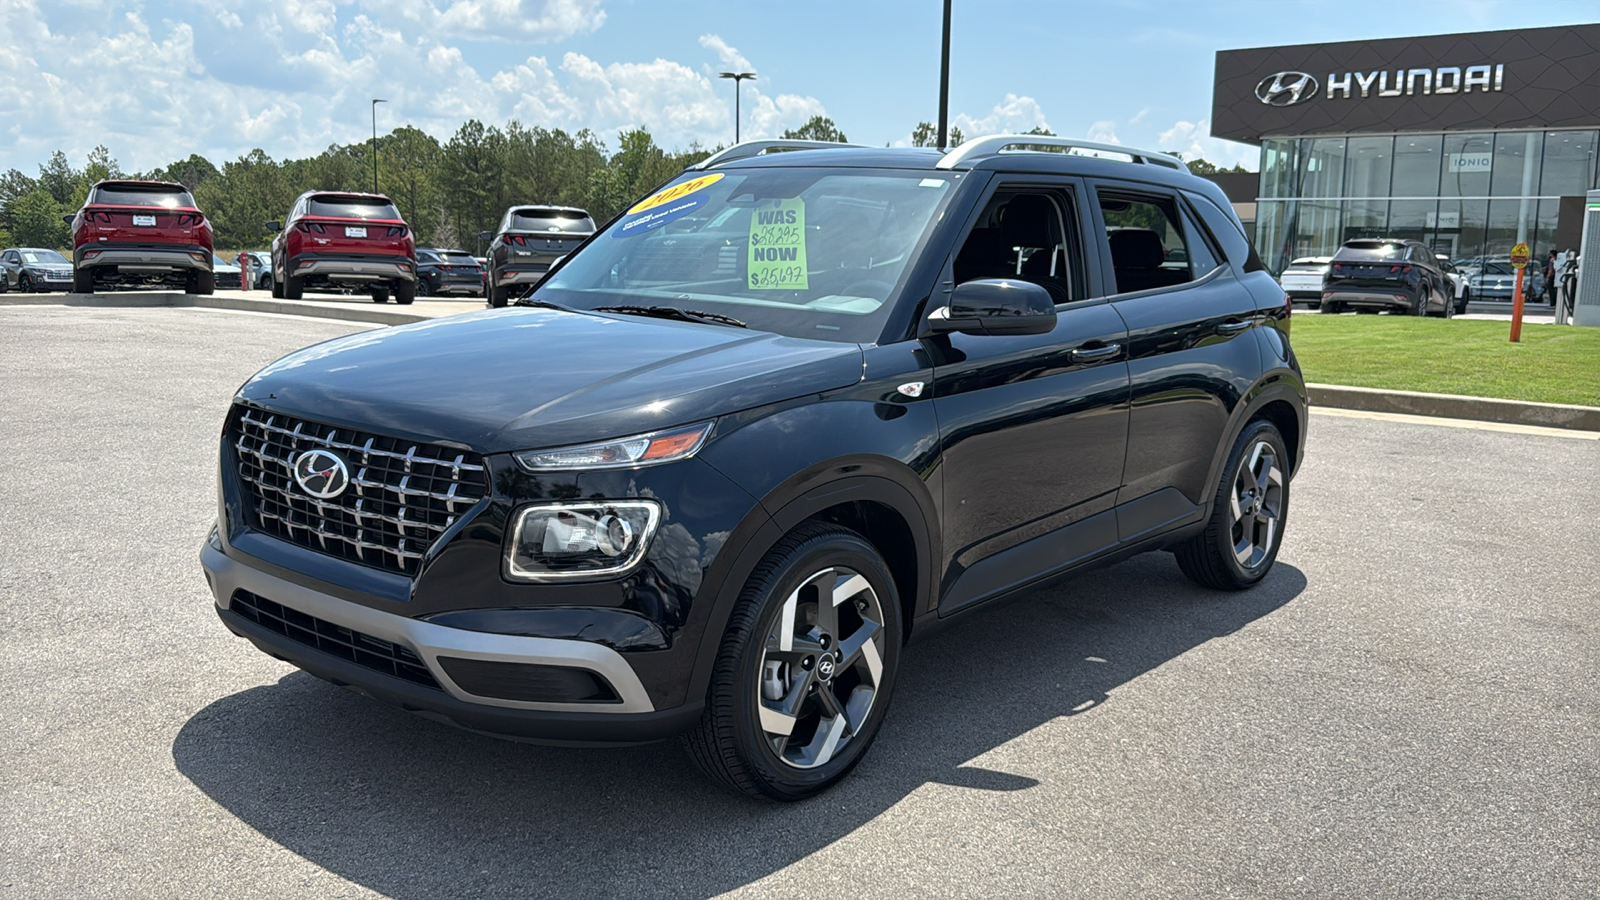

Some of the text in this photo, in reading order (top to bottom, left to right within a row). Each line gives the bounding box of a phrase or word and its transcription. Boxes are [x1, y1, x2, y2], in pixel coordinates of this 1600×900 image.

[1327, 64, 1504, 99] HYUNDAI
[1454, 158, 1490, 167] IONIQ
[758, 210, 796, 225] WAS
[754, 247, 797, 261] NOW
[751, 266, 803, 287] $25,697
